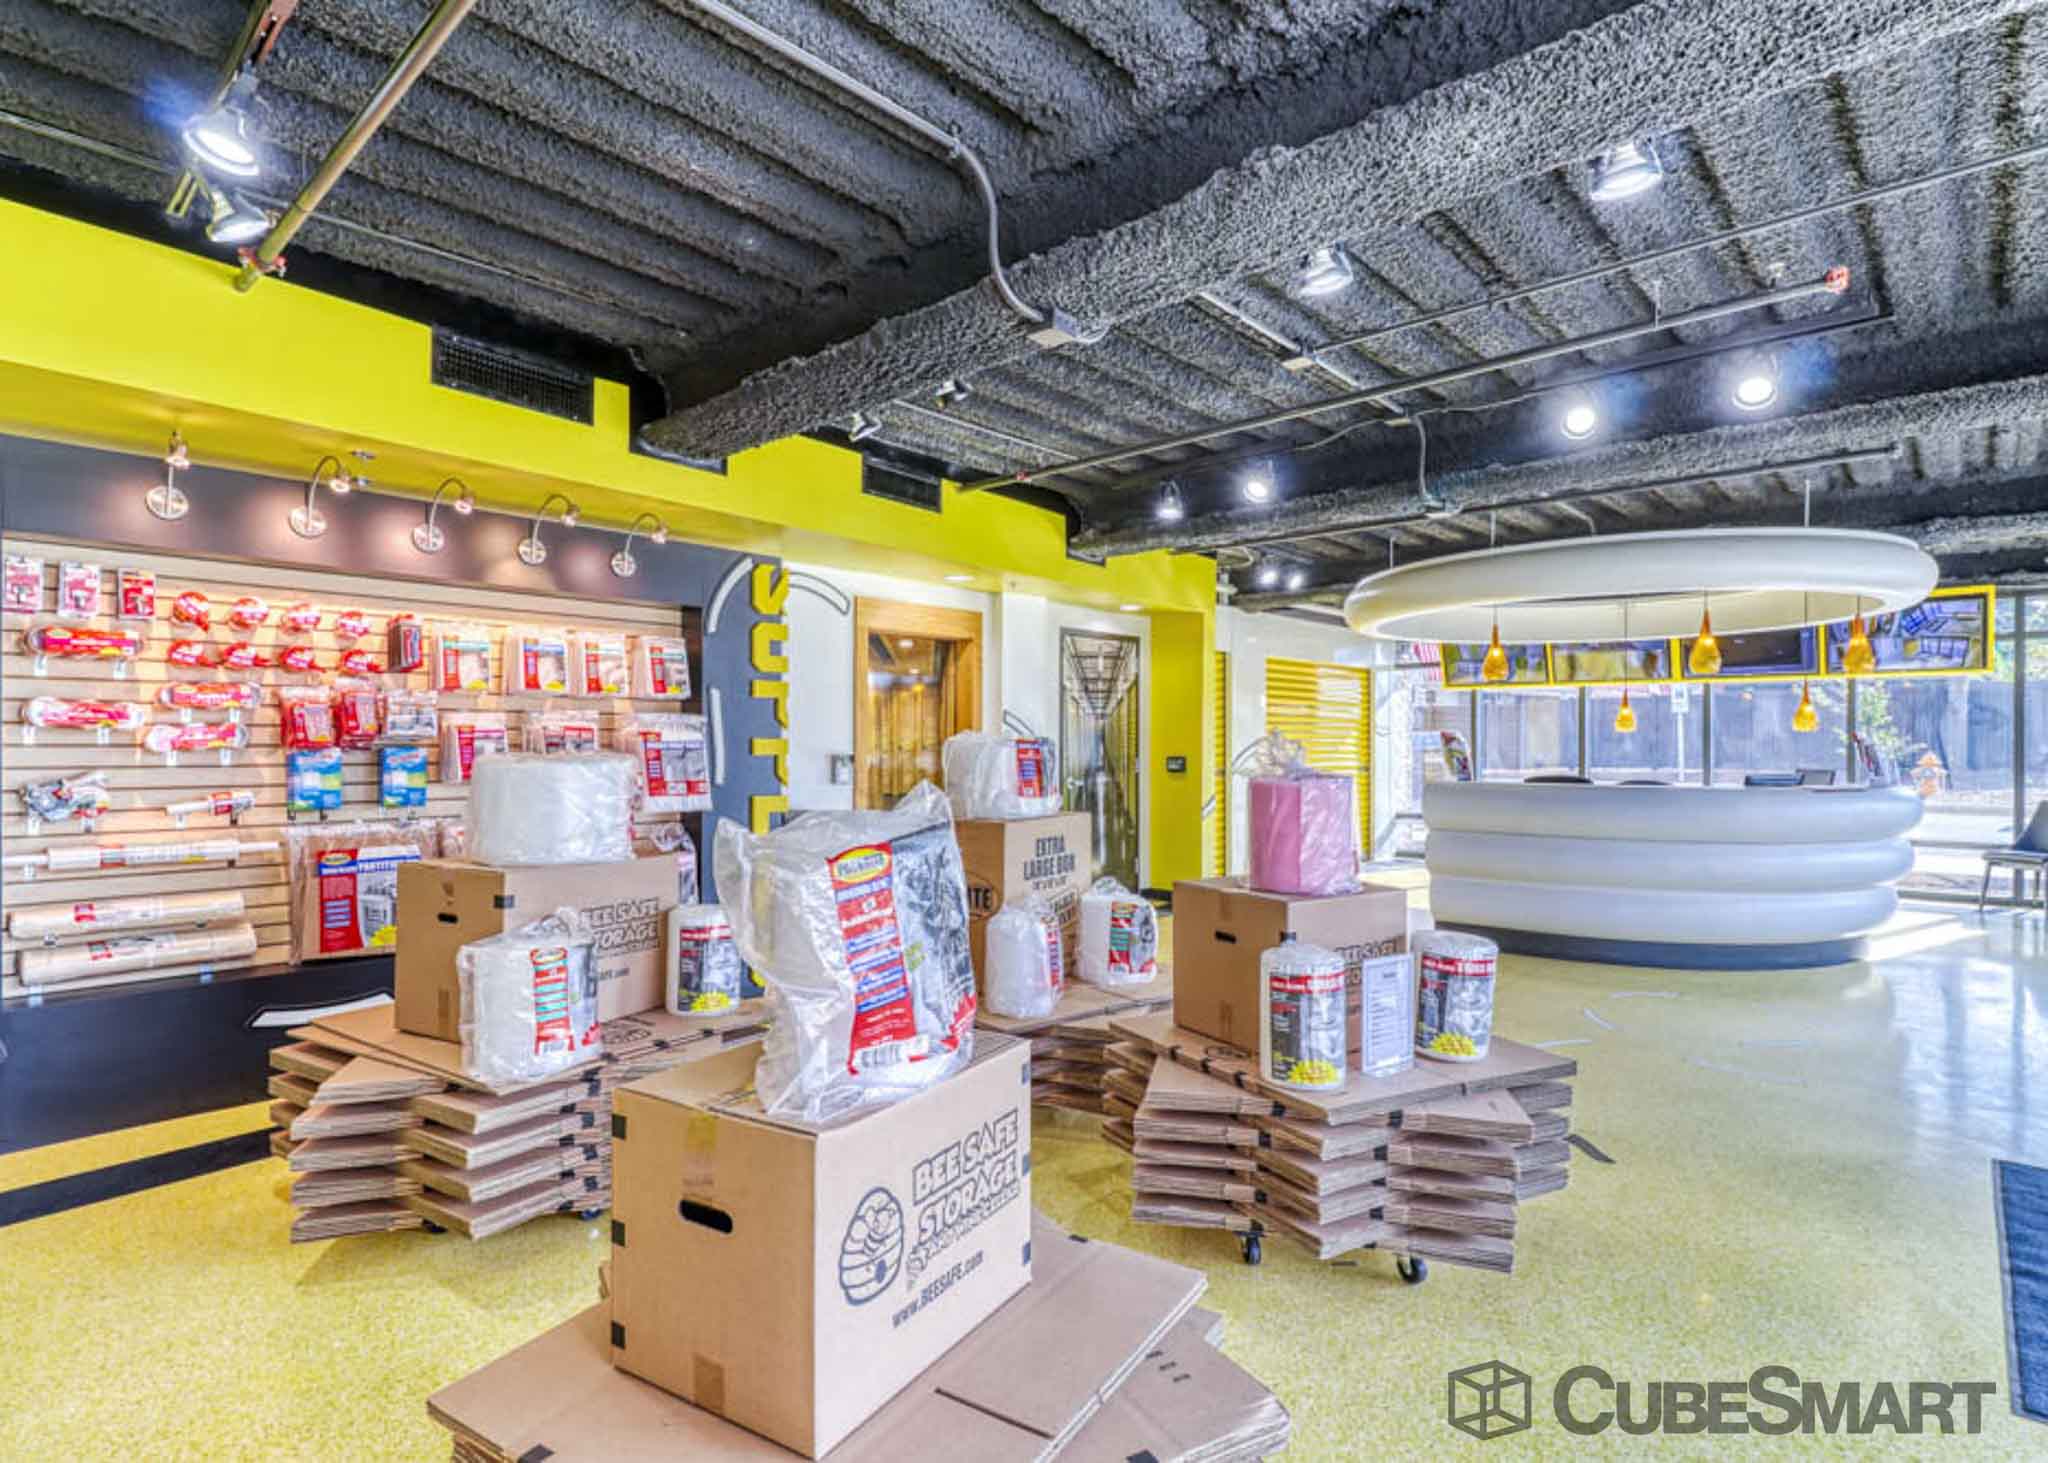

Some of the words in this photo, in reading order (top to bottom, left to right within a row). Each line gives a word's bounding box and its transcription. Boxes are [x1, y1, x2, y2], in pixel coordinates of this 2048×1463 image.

[750, 562, 790, 838] SUPPL
[1023, 857, 1055, 880] LARGE
[1035, 834, 1065, 857] EXTRA
[592, 921, 659, 950] TORAGE
[912, 1140, 961, 1206] BEE
[962, 1107, 1019, 1174] SAFE
[918, 1149, 1018, 1246] STORAGE
